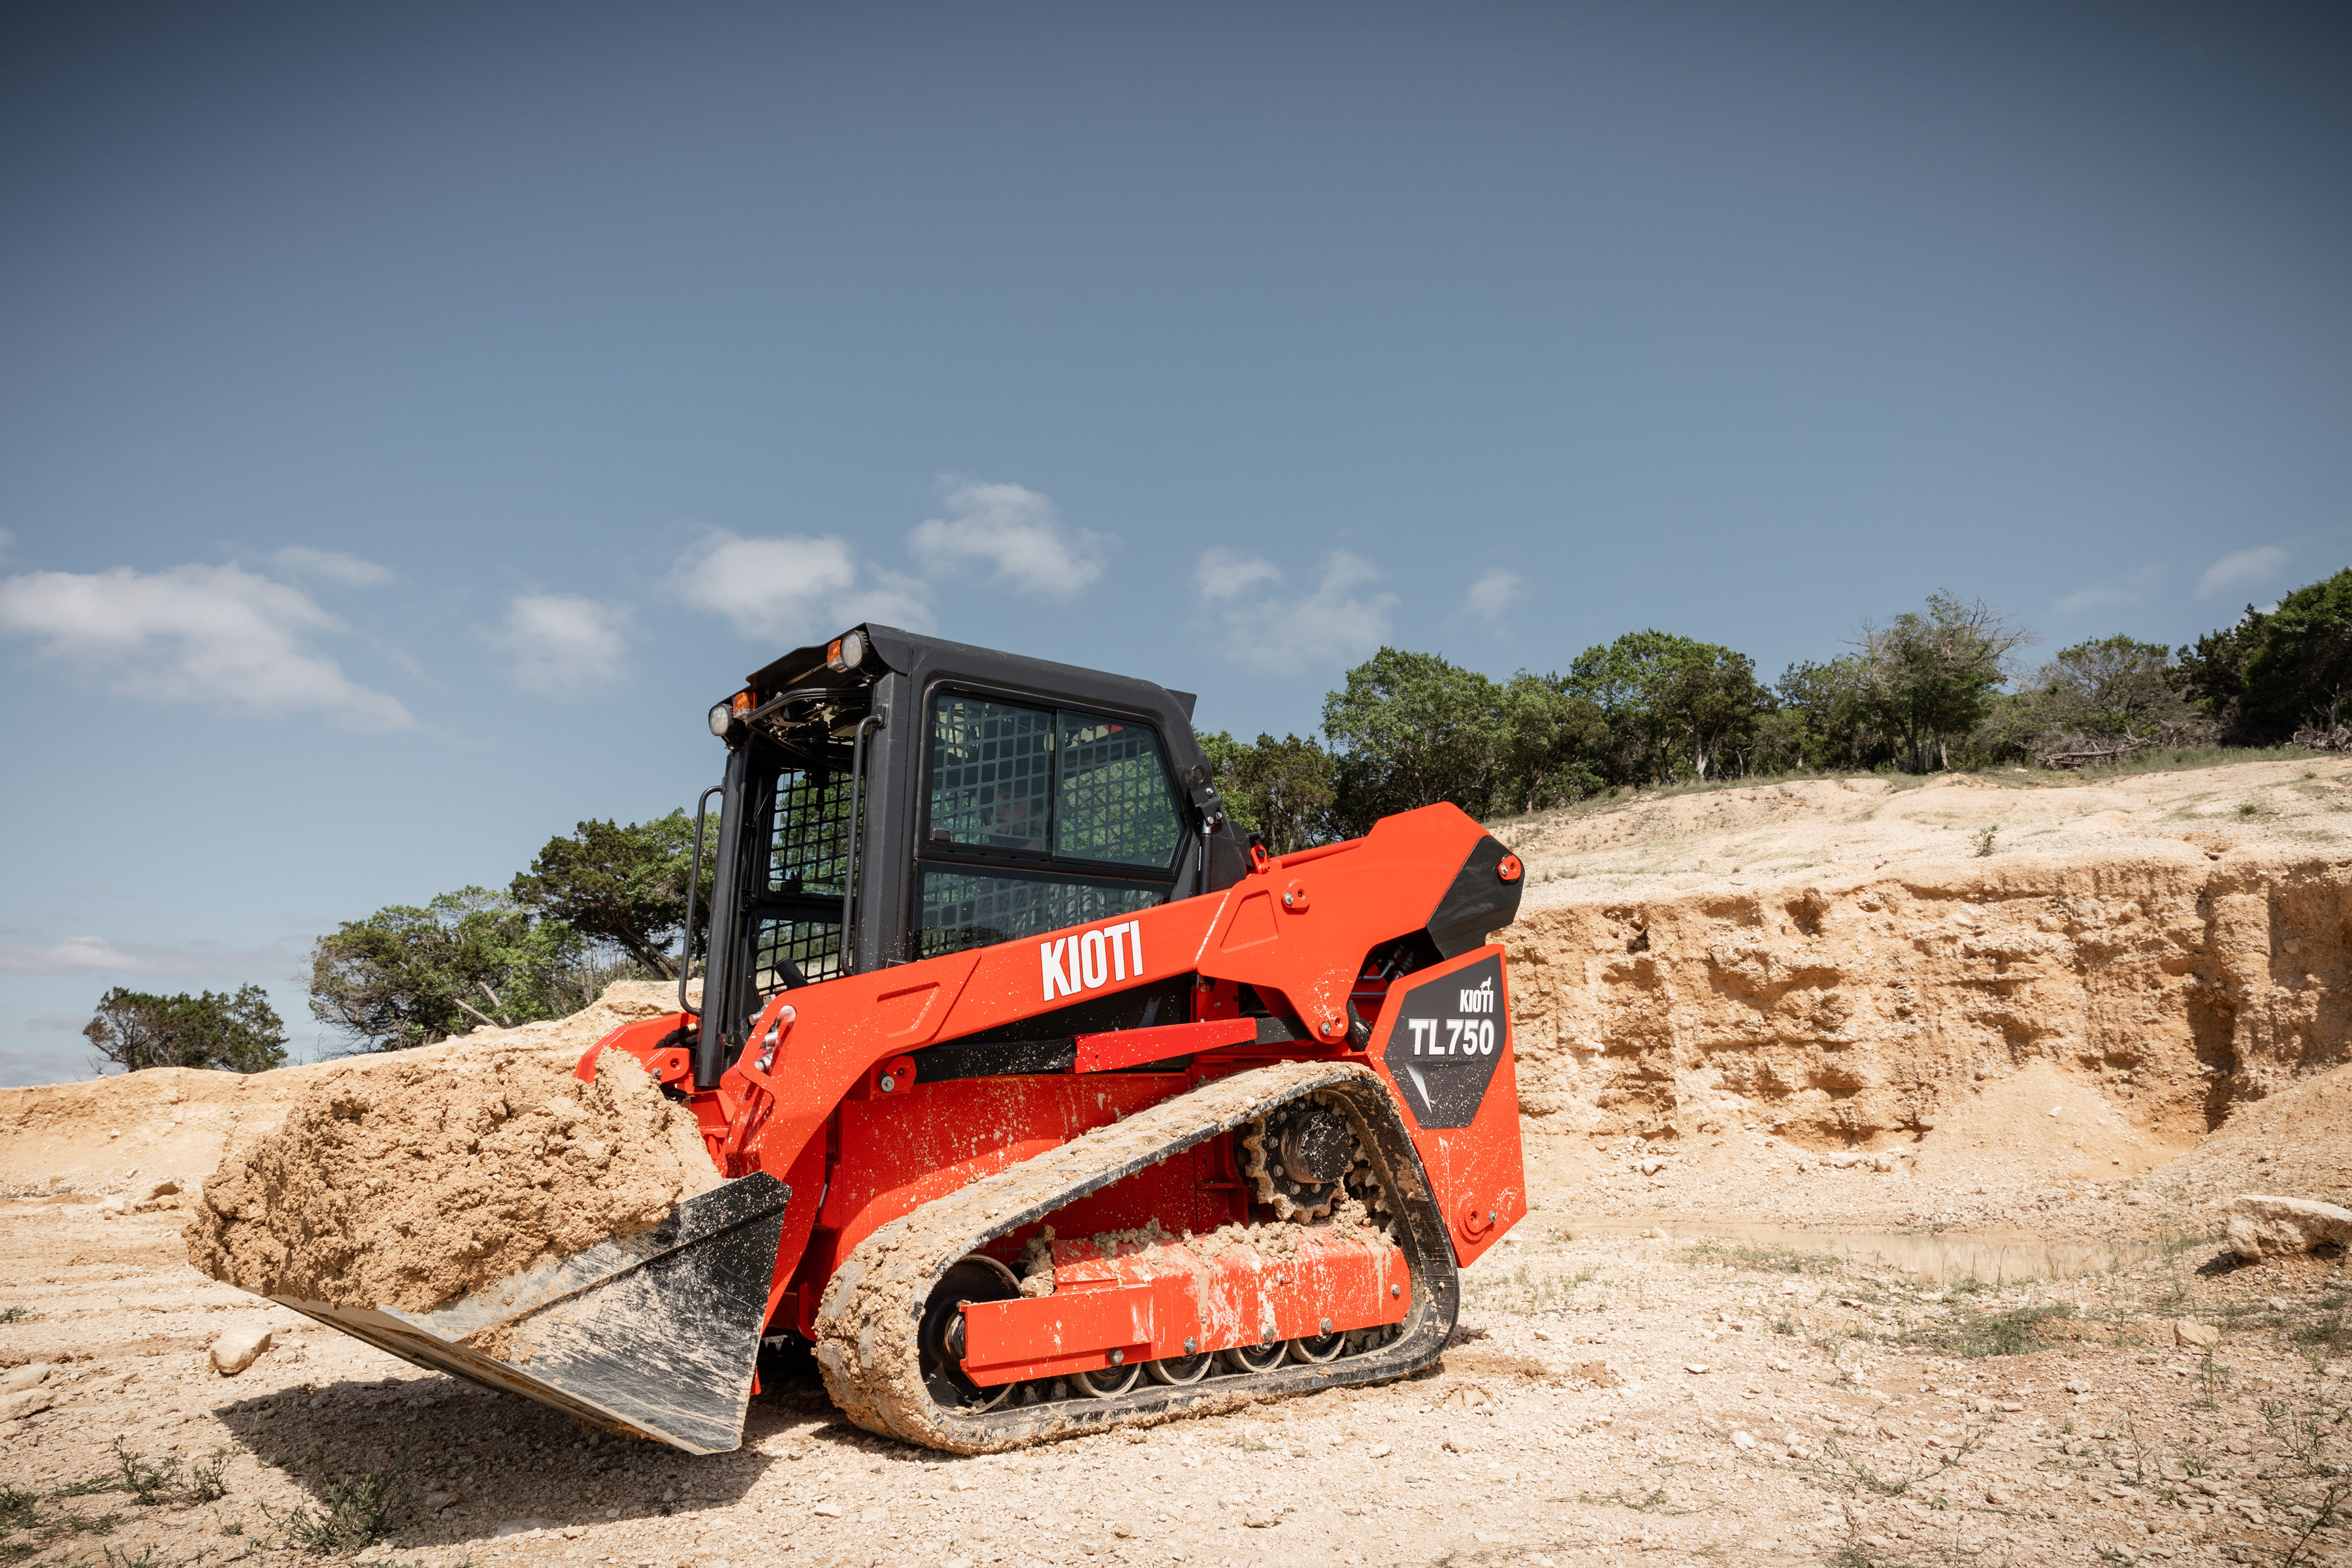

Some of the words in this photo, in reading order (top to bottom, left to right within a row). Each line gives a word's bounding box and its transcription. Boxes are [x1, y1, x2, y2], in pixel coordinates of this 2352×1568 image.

[1040, 919, 1143, 1002] KIOTI
[1460, 989, 1494, 1013] KIOTI
[1408, 1019, 1495, 1056] TL750
